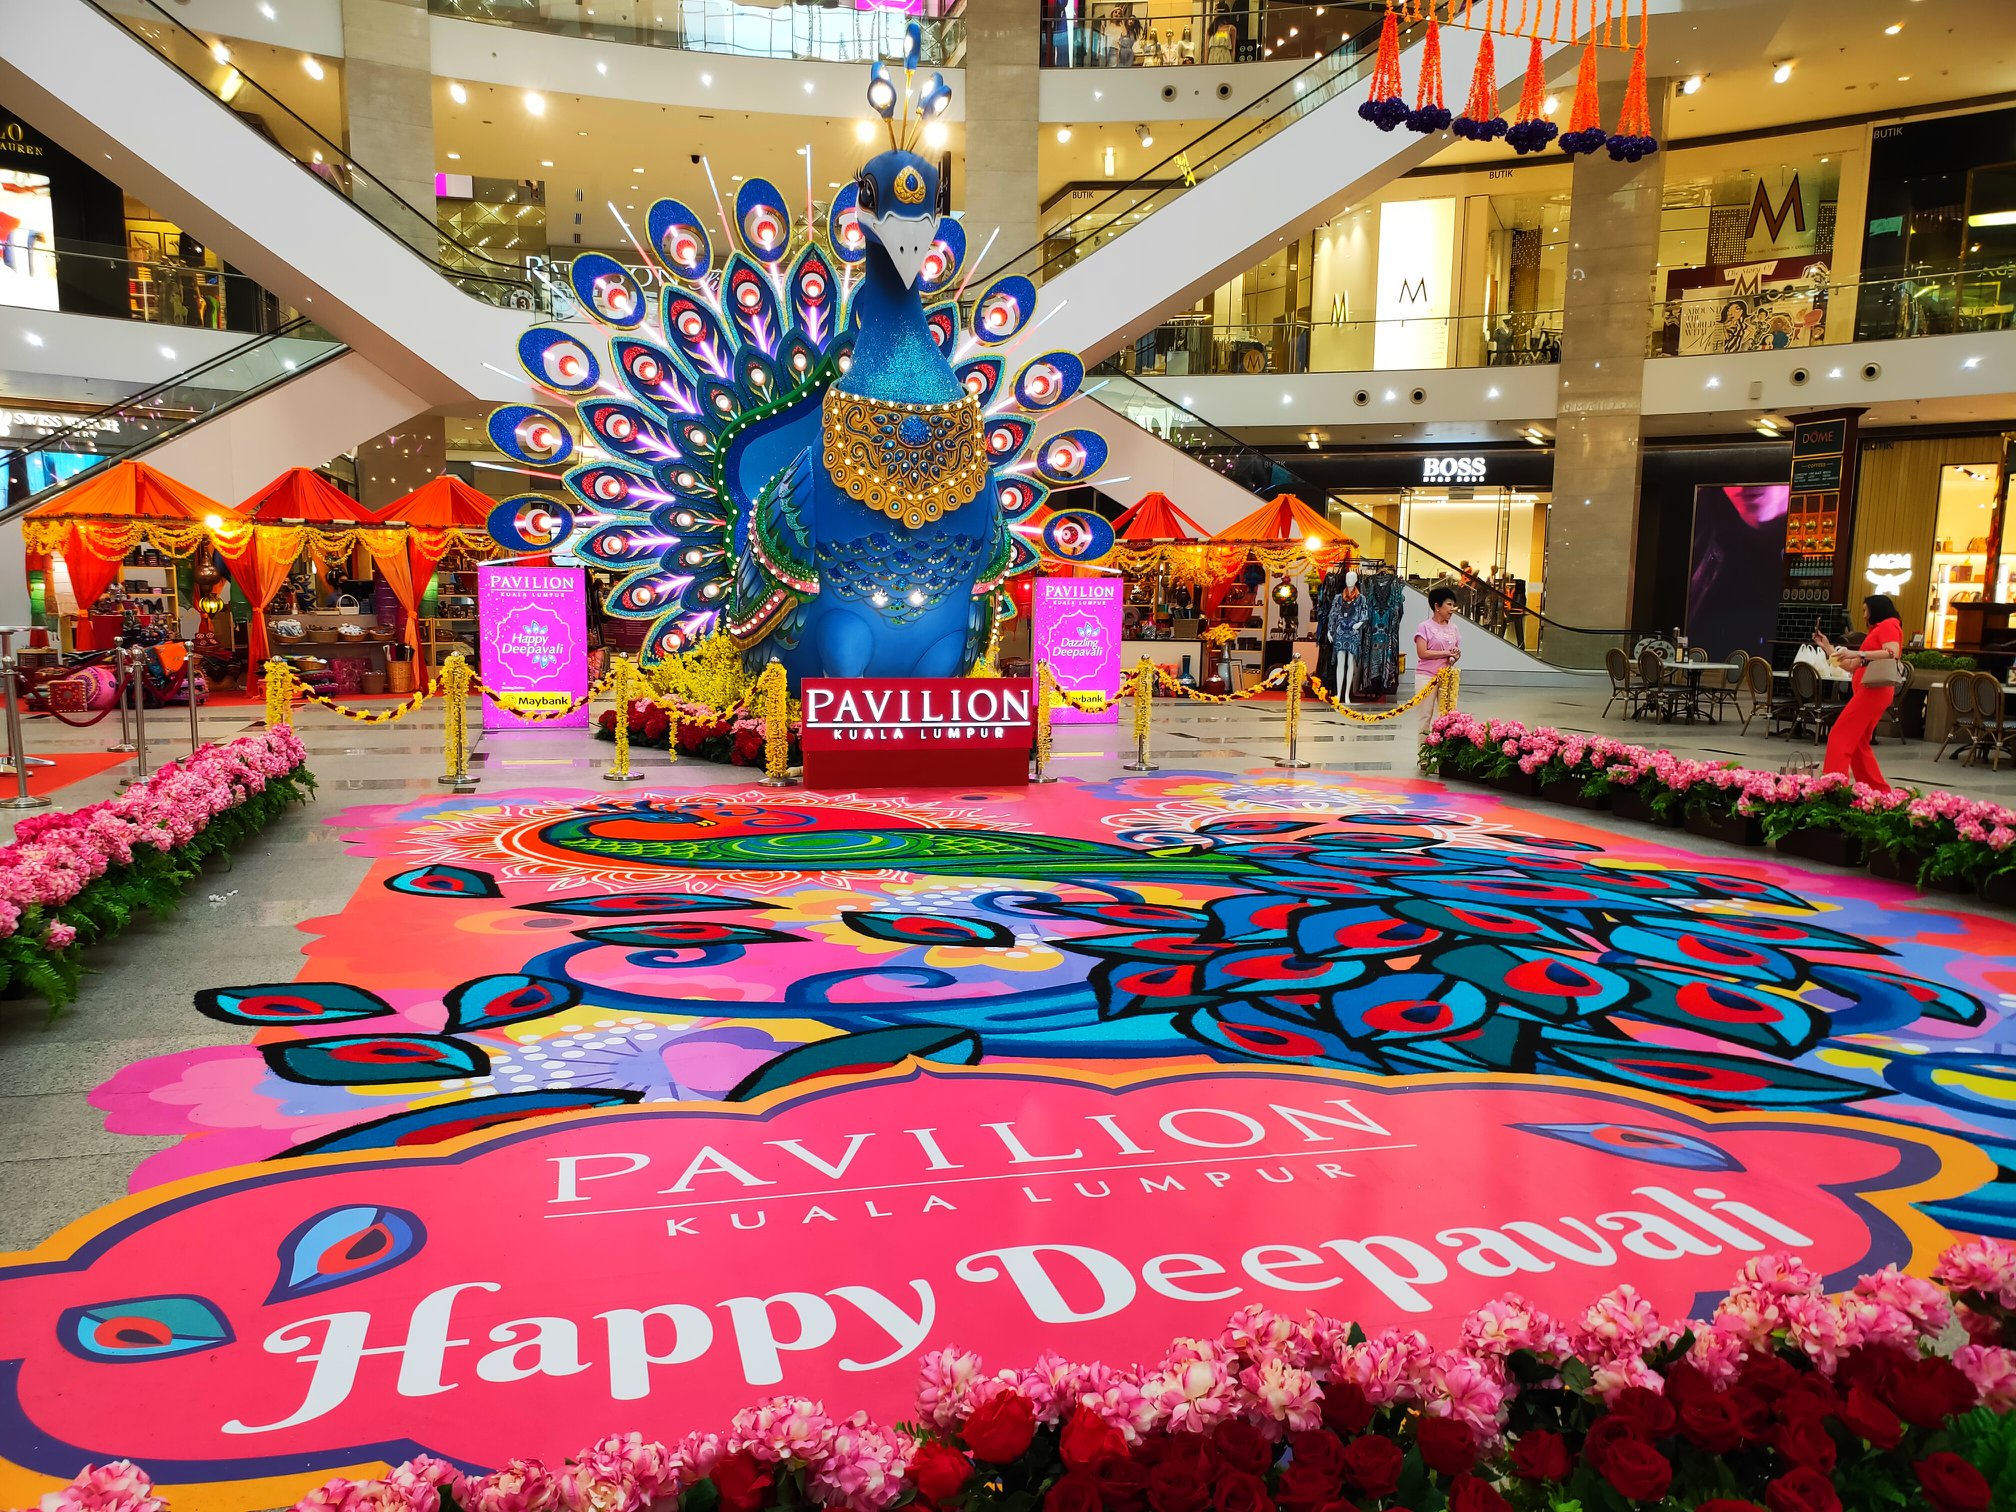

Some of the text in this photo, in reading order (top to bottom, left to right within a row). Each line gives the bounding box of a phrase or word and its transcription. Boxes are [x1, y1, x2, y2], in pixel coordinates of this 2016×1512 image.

[1874, 126, 1903, 139] BUTIK
[1489, 169, 1513, 179] BUTIK
[1072, 191, 1094, 199] BUTIK
[1744, 172, 1806, 244] M
[1398, 276, 1428, 304] M
[1331, 289, 1350, 328] M
[1247, 355, 1261, 369] M
[13, 412, 62, 427] SWISS
[1422, 457, 1487, 476] BOSS
[490, 576, 574, 589] PAVILION
[1045, 585, 1114, 598] PAVILION
[511, 633, 549, 646] Happy
[1060, 637, 1099, 650] Dazzling
[501, 643, 564, 657] Deepavali
[1052, 646, 1103, 659] Deepavali
[518, 696, 568, 707] Maybank
[805, 689, 1030, 723] PAVILION
[833, 727, 1005, 740] KUALA LUMPUR
[546, 1099, 1392, 1203] PAVILION
[666, 1163, 1356, 1237] KUALA LUMPUR
[220, 1185, 1815, 1436] Happy Deepavali
